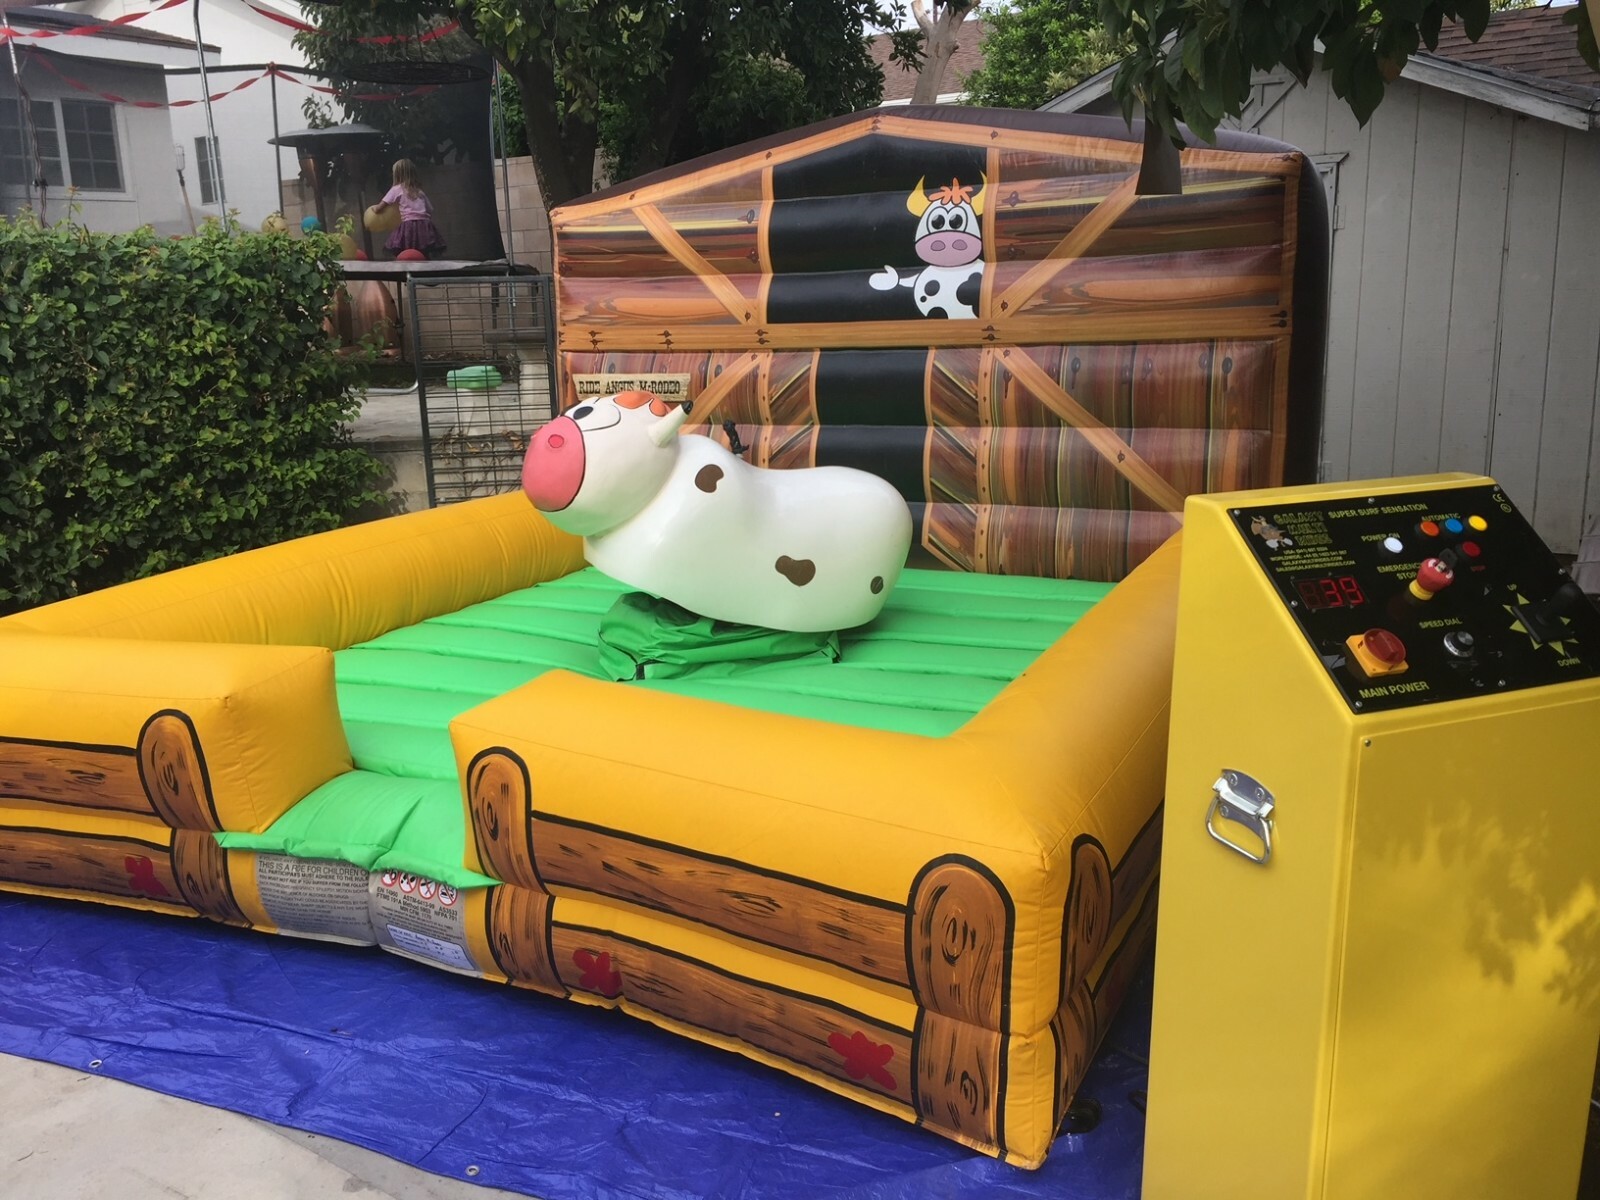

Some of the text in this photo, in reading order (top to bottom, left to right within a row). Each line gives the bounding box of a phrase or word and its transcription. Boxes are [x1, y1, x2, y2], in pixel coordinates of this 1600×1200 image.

[578, 380, 600, 394] RIDE
[605, 380, 634, 394] ANGUS
[1328, 503, 1428, 520] SUPER SURF SENSATION
[1274, 511, 1324, 524] GALAXY
[1421, 513, 1462, 522] AUTOMATIC
[1360, 534, 1387, 542] POWER
[1376, 562, 1422, 574] EMERGENC
[1396, 572, 1418, 580] STOP
[1507, 584, 1518, 592] UP
[1418, 618, 1463, 629] SPEED DIAL
[1557, 657, 1580, 667] DOWN
[1358, 681, 1430, 699] MAIN POWER
[259, 860, 274, 869] THIS
[323, 866, 359, 876] CHILDREN
